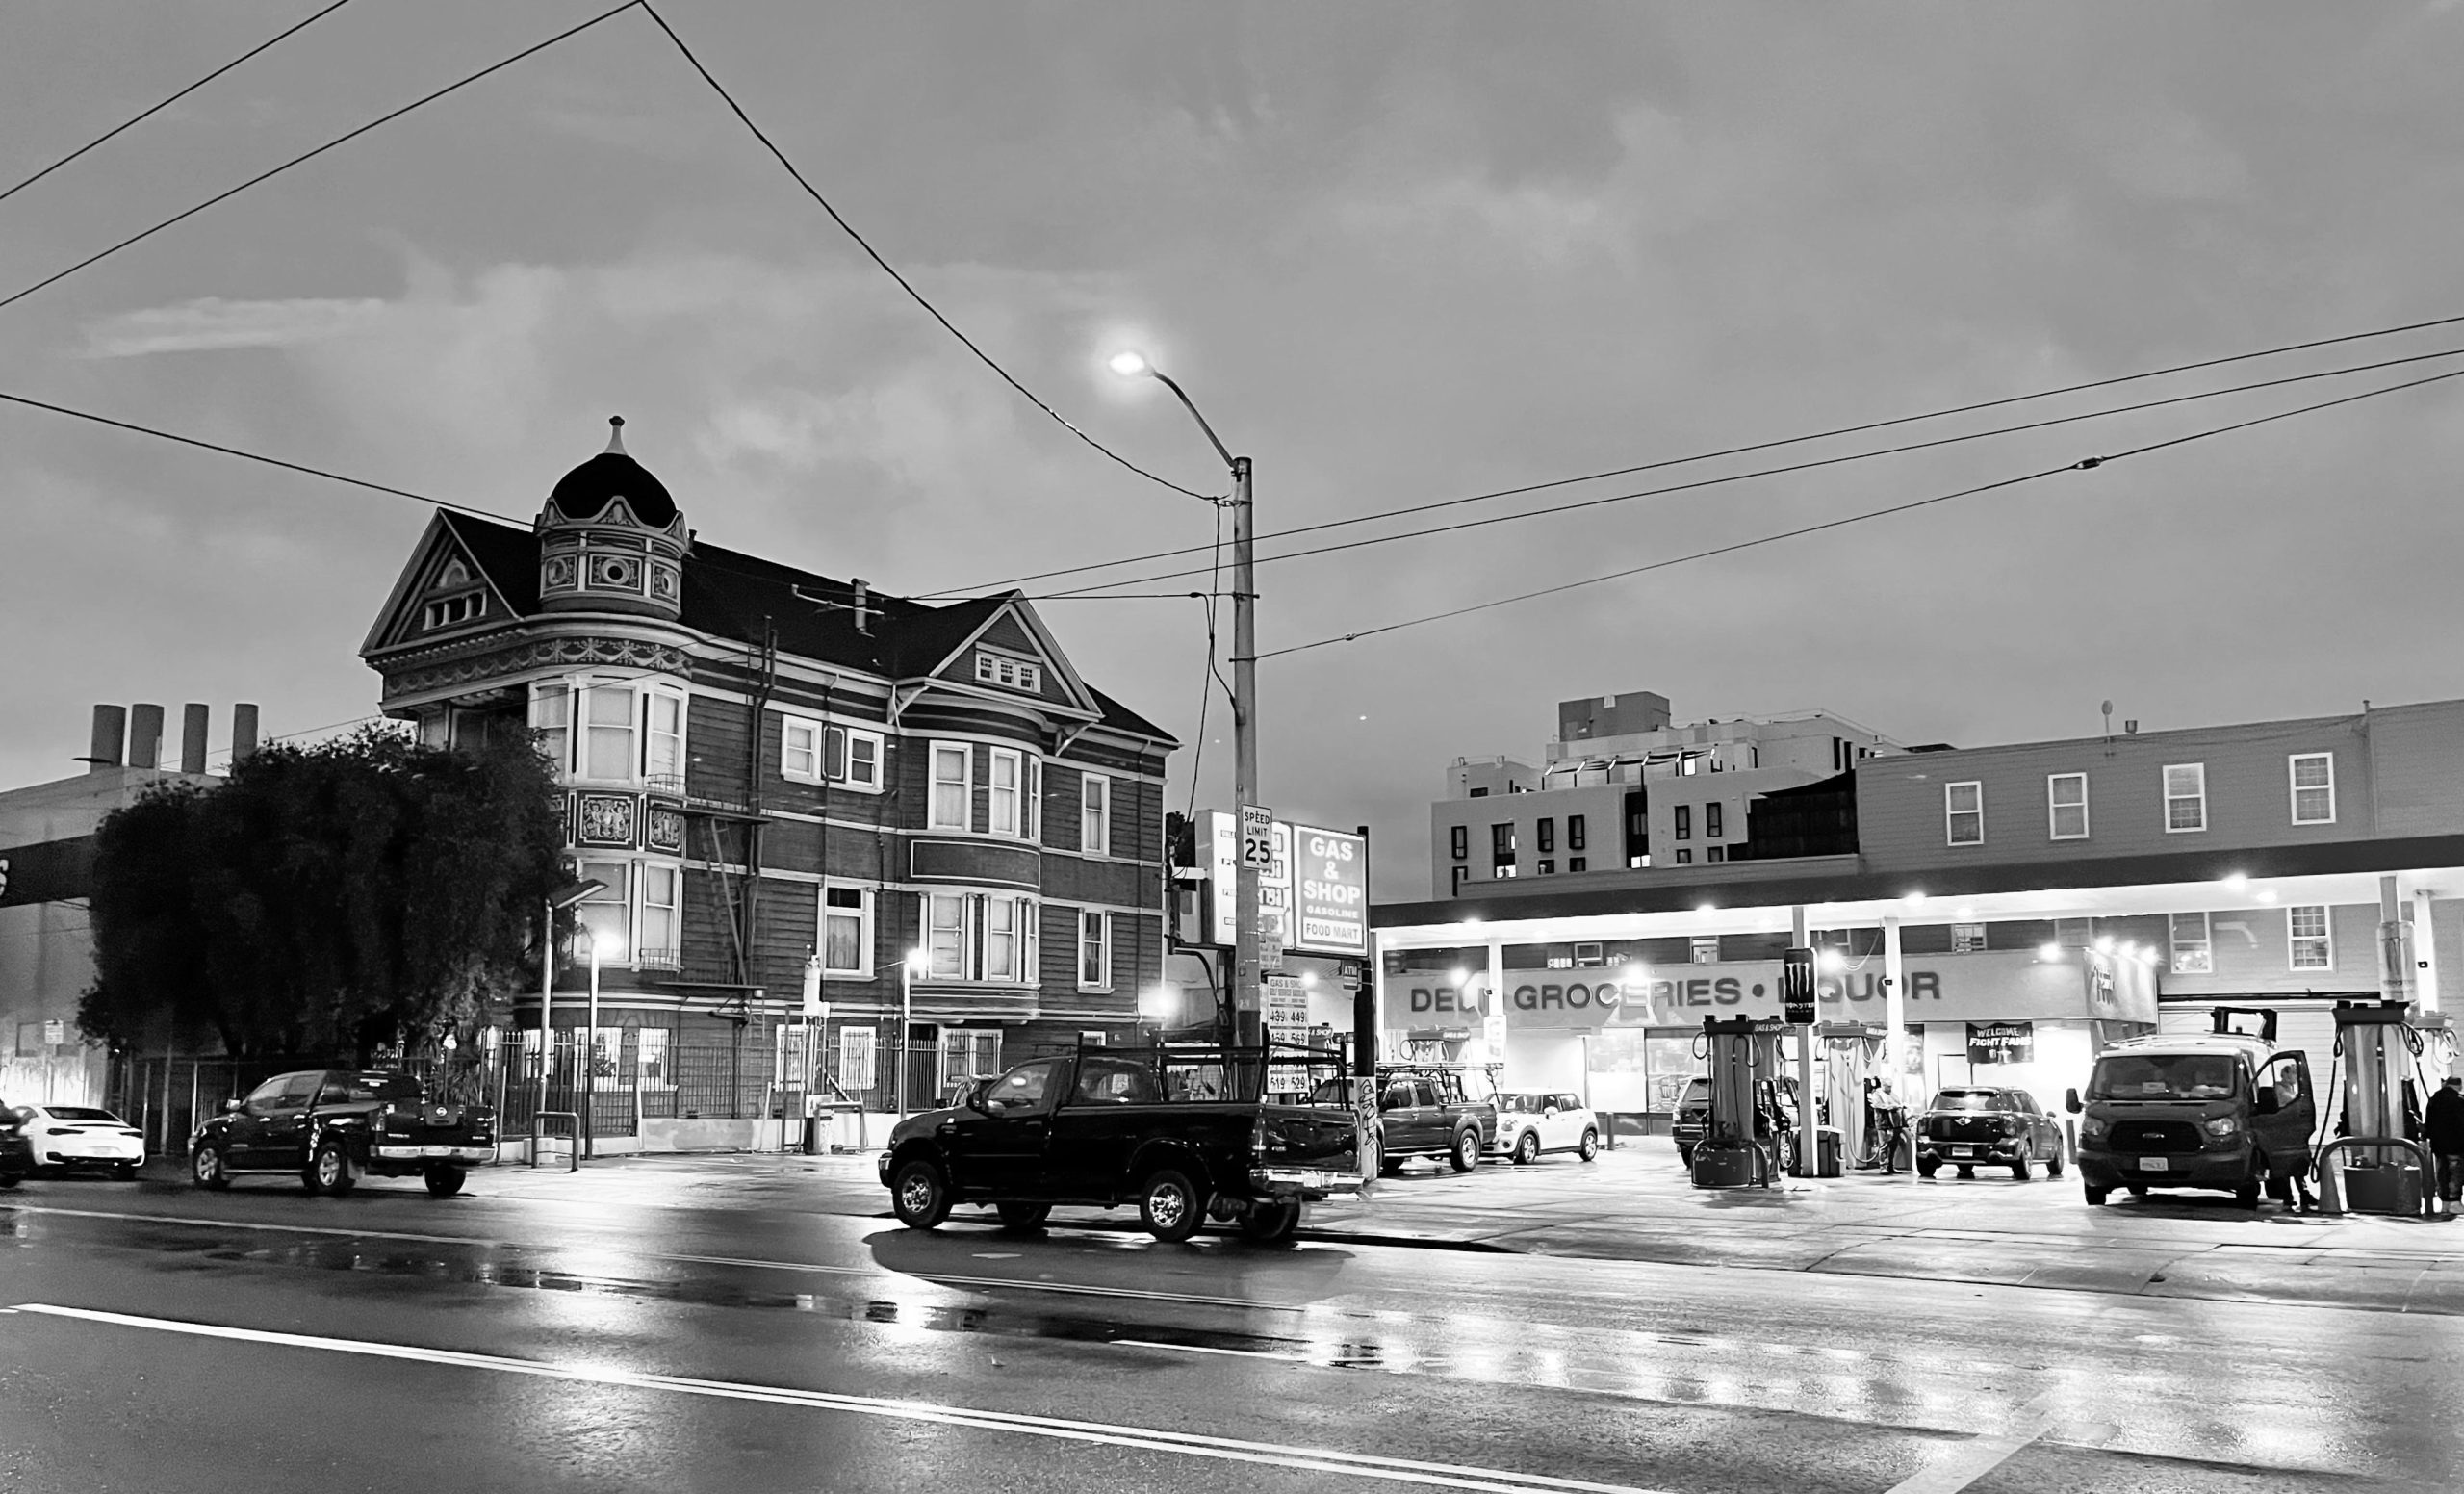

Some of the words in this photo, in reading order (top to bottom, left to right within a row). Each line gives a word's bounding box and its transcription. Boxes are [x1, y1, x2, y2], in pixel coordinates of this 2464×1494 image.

[1244, 811, 1270, 825] SPEED
[1246, 825, 1268, 837] LIMIT
[1245, 837, 1270, 863] 25
[1309, 836, 1354, 862] GAS
[1323, 860, 1340, 880] &
[1302, 878, 1362, 905] SHOP
[1305, 904, 1359, 920] GASOLINE
[1305, 922, 1332, 937] FOOD
[1333, 924, 1359, 940] MART
[1344, 964, 1358, 976] ATM
[1513, 976, 1742, 1012] GROCERIES
[1976, 1026, 2020, 1038] WELCOME
[1968, 1037, 2001, 1047] FIGHT
